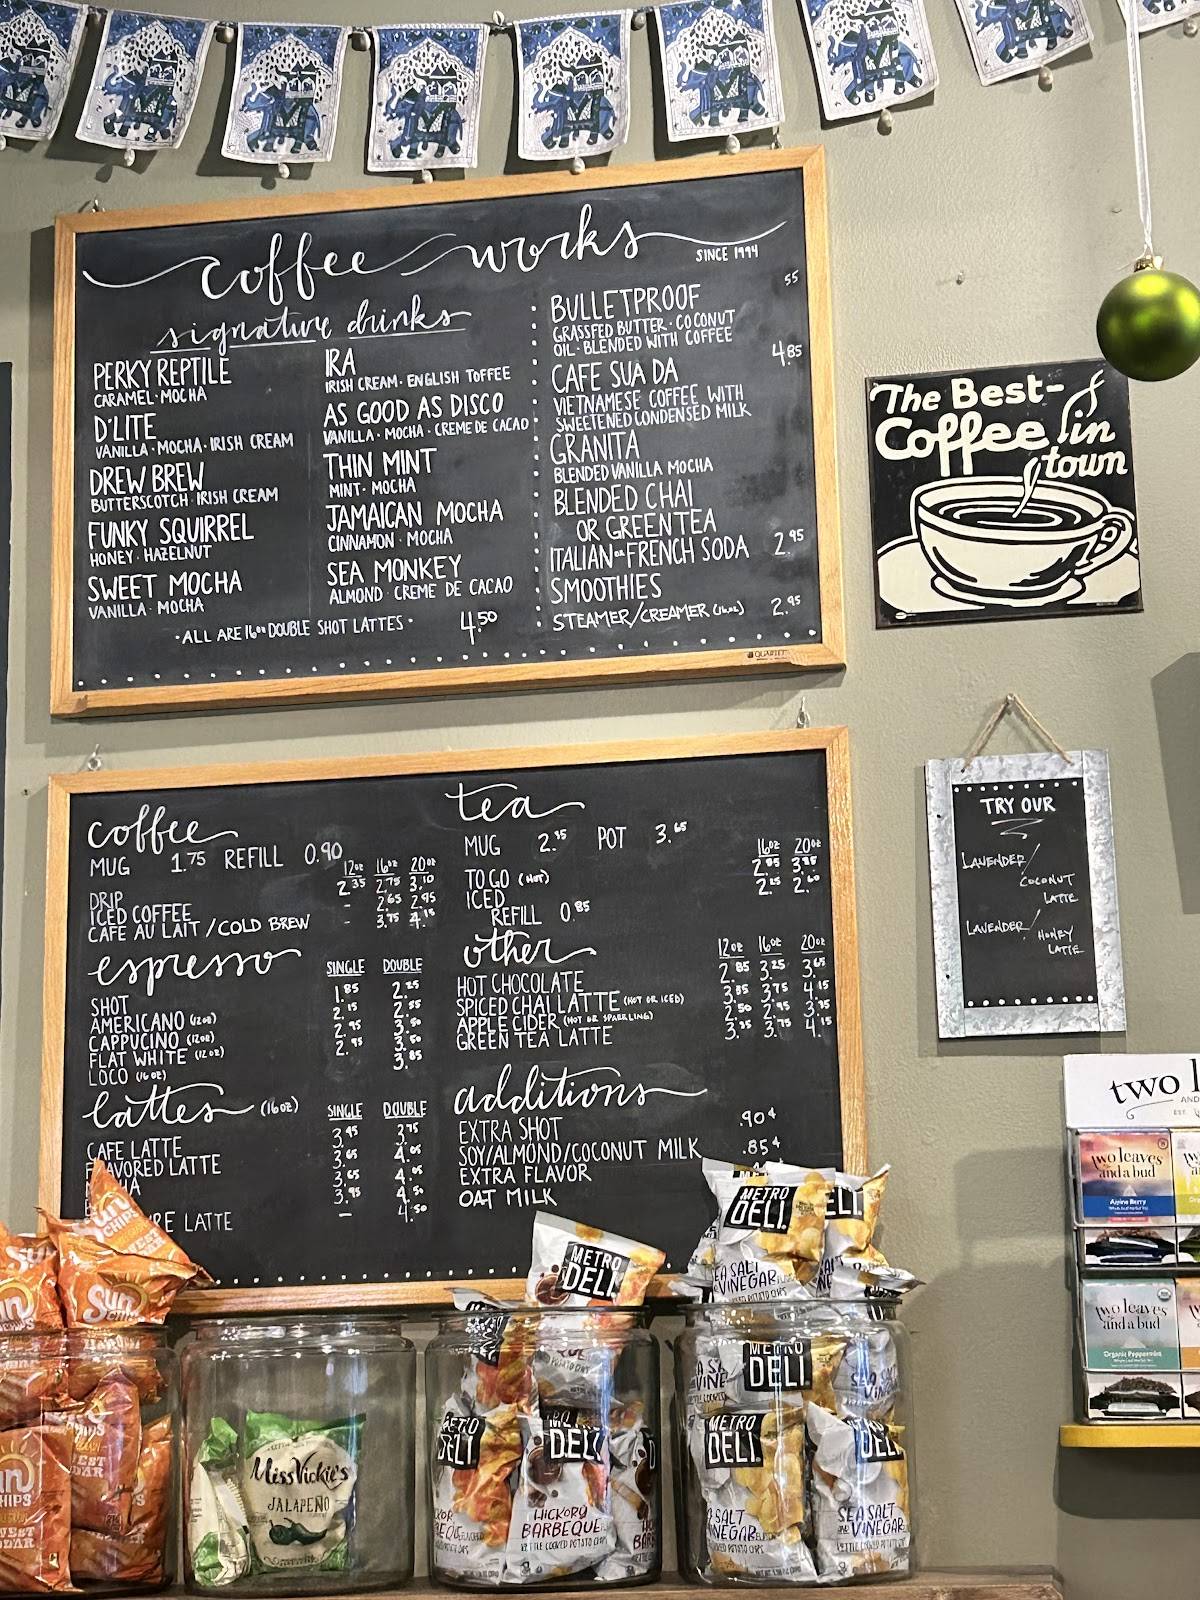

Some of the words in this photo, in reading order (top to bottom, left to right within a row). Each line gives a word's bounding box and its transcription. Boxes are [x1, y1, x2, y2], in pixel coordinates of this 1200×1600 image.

[696, 247, 728, 262] SINCE
[734, 244, 758, 259] 1994
[550, 284, 700, 323] BULLETPROOF
[157, 307, 332, 355] signature
[347, 294, 472, 335] drinks
[553, 321, 613, 342] GRASSFED
[617, 318, 666, 336] BUTTER
[676, 310, 736, 329] COCONUT
[94, 360, 151, 390] PERKY
[158, 357, 232, 386] REPTILE
[325, 348, 355, 377] IRA
[552, 362, 602, 394] CAFE
[610, 360, 646, 389] SUA
[652, 357, 679, 384] DA
[325, 378, 353, 393] IRISH
[358, 375, 398, 390] CREAM
[407, 371, 459, 388] ENGLISH
[466, 366, 511, 381] TOFFEE
[324, 403, 347, 427] AS
[357, 399, 409, 424] GOOD
[417, 396, 442, 420] AS
[451, 392, 504, 417] DISCO
[553, 390, 641, 416] VIETNAMESE
[649, 384, 698, 408] COFFEE
[708, 384, 743, 401] WITH
[870, 383, 941, 415] The
[96, 442, 148, 459] VANILLA
[158, 437, 202, 455] MOCHA
[210, 435, 243, 451] IRISH
[250, 433, 293, 449] CREAM
[550, 429, 640, 464] GRANITA
[875, 411, 1049, 477] Coffee
[1067, 409, 1115, 445] in
[323, 451, 372, 480] THIN
[382, 448, 437, 475] MINT
[554, 464, 608, 484] BLENDED
[612, 460, 663, 479] VANILLA
[668, 457, 713, 475] MOCHA
[1042, 446, 1128, 478] town
[90, 466, 145, 495] DREW
[152, 462, 204, 492] BREW
[91, 494, 188, 513] BUTTERSCOTCH
[197, 490, 227, 505] IRISH
[233, 487, 278, 503] CREAM
[554, 484, 638, 516] BLENDED
[646, 479, 693, 509] CHAI
[326, 501, 422, 532] JAMAICAN
[437, 499, 503, 525] MOCHA
[88, 519, 147, 549] FUNKY
[160, 513, 254, 545] SQUIRREL
[774, 529, 804, 556] 2.95
[90, 549, 133, 567] HONEY
[144, 545, 211, 562] HAZELNUT
[702, 535, 749, 562] SODA
[327, 561, 364, 586] SEA
[375, 554, 462, 582] MONKEY
[88, 574, 157, 601] SWEET
[170, 570, 242, 597] MOCHA
[330, 586, 383, 604] ALMOND
[394, 583, 436, 600] CREME
[446, 581, 462, 597] DE
[469, 576, 513, 595] CACAO
[551, 573, 662, 604] SMOOTHIES
[771, 596, 801, 616] 2.95
[460, 610, 497, 645] 4.50
[445, 783, 585, 822] tea
[980, 798, 1014, 815] TRY
[1021, 796, 1055, 813] OUR
[88, 804, 239, 854] coffee
[465, 835, 500, 856] MUG
[598, 827, 626, 850] POT
[90, 857, 130, 876] MUG
[171, 852, 206, 873] 1.75
[225, 845, 283, 870] REFILL
[305, 842, 342, 865] 0.90
[1020, 874, 1075, 887] COCONUT
[89, 891, 123, 911] DRIP
[467, 889, 505, 909] ICED
[1044, 893, 1078, 904] LATTE
[90, 908, 127, 926] ICED
[133, 903, 192, 923] COFFEE
[491, 905, 542, 926] REFILL
[560, 901, 590, 922] 0.85
[88, 926, 126, 942] CAFE
[135, 924, 154, 940] AU
[162, 921, 200, 939] LAIT
[269, 914, 310, 931] BREW
[1038, 926, 1074, 942] HONEY
[464, 928, 596, 968] other
[1048, 945, 1084, 955] LATTE
[88, 949, 302, 996] espresso
[326, 959, 365, 975] SINGLE
[383, 958, 422, 972] DOUBLE
[458, 976, 487, 997] HOT
[492, 971, 584, 994] CHOCOLATE
[91, 995, 129, 1016] SHOT
[91, 1011, 184, 1034] AMERICANO
[89, 1032, 179, 1052] CAPPUCINO
[457, 1029, 508, 1050] GREEN
[514, 1031, 549, 1049] TEA
[559, 1026, 612, 1047] LATTE
[89, 1052, 127, 1068] FLAT
[133, 1048, 187, 1067] WHITE
[89, 1068, 128, 1086] LOCO
[454, 1064, 707, 1115] additions
[1109, 1074, 1179, 1104] two
[82, 1083, 254, 1128] lattes
[459, 1120, 512, 1144] EXTRA
[519, 1116, 562, 1141] SHOT
[87, 1141, 123, 1161] CAFE
[131, 1136, 181, 1159] LATTE
[658, 1137, 703, 1160] MILK
[1119, 1148, 1163, 1165] leaves
[460, 1166, 516, 1186] EXTRA
[525, 1163, 592, 1183] FLAVOR
[459, 1189, 496, 1210] OAT
[507, 1187, 557, 1207] MILK
[741, 1188, 789, 1200] METRO
[571, 1246, 621, 1270] METRO
[731, 1257, 758, 1276] SALT
[718, 1271, 776, 1294] VINEGAR
[1123, 1299, 1167, 1317] leaves
[709, 1415, 756, 1431] METRO
[251, 1457, 293, 1485] Miss
[292, 1452, 349, 1490] Vickie's
[534, 1506, 588, 1520] HICKORY
[838, 1505, 864, 1522] SEA
[868, 1503, 895, 1519] SALT
[522, 1518, 601, 1538] BARBEQUE
[851, 1519, 905, 1537] VINEGAR
